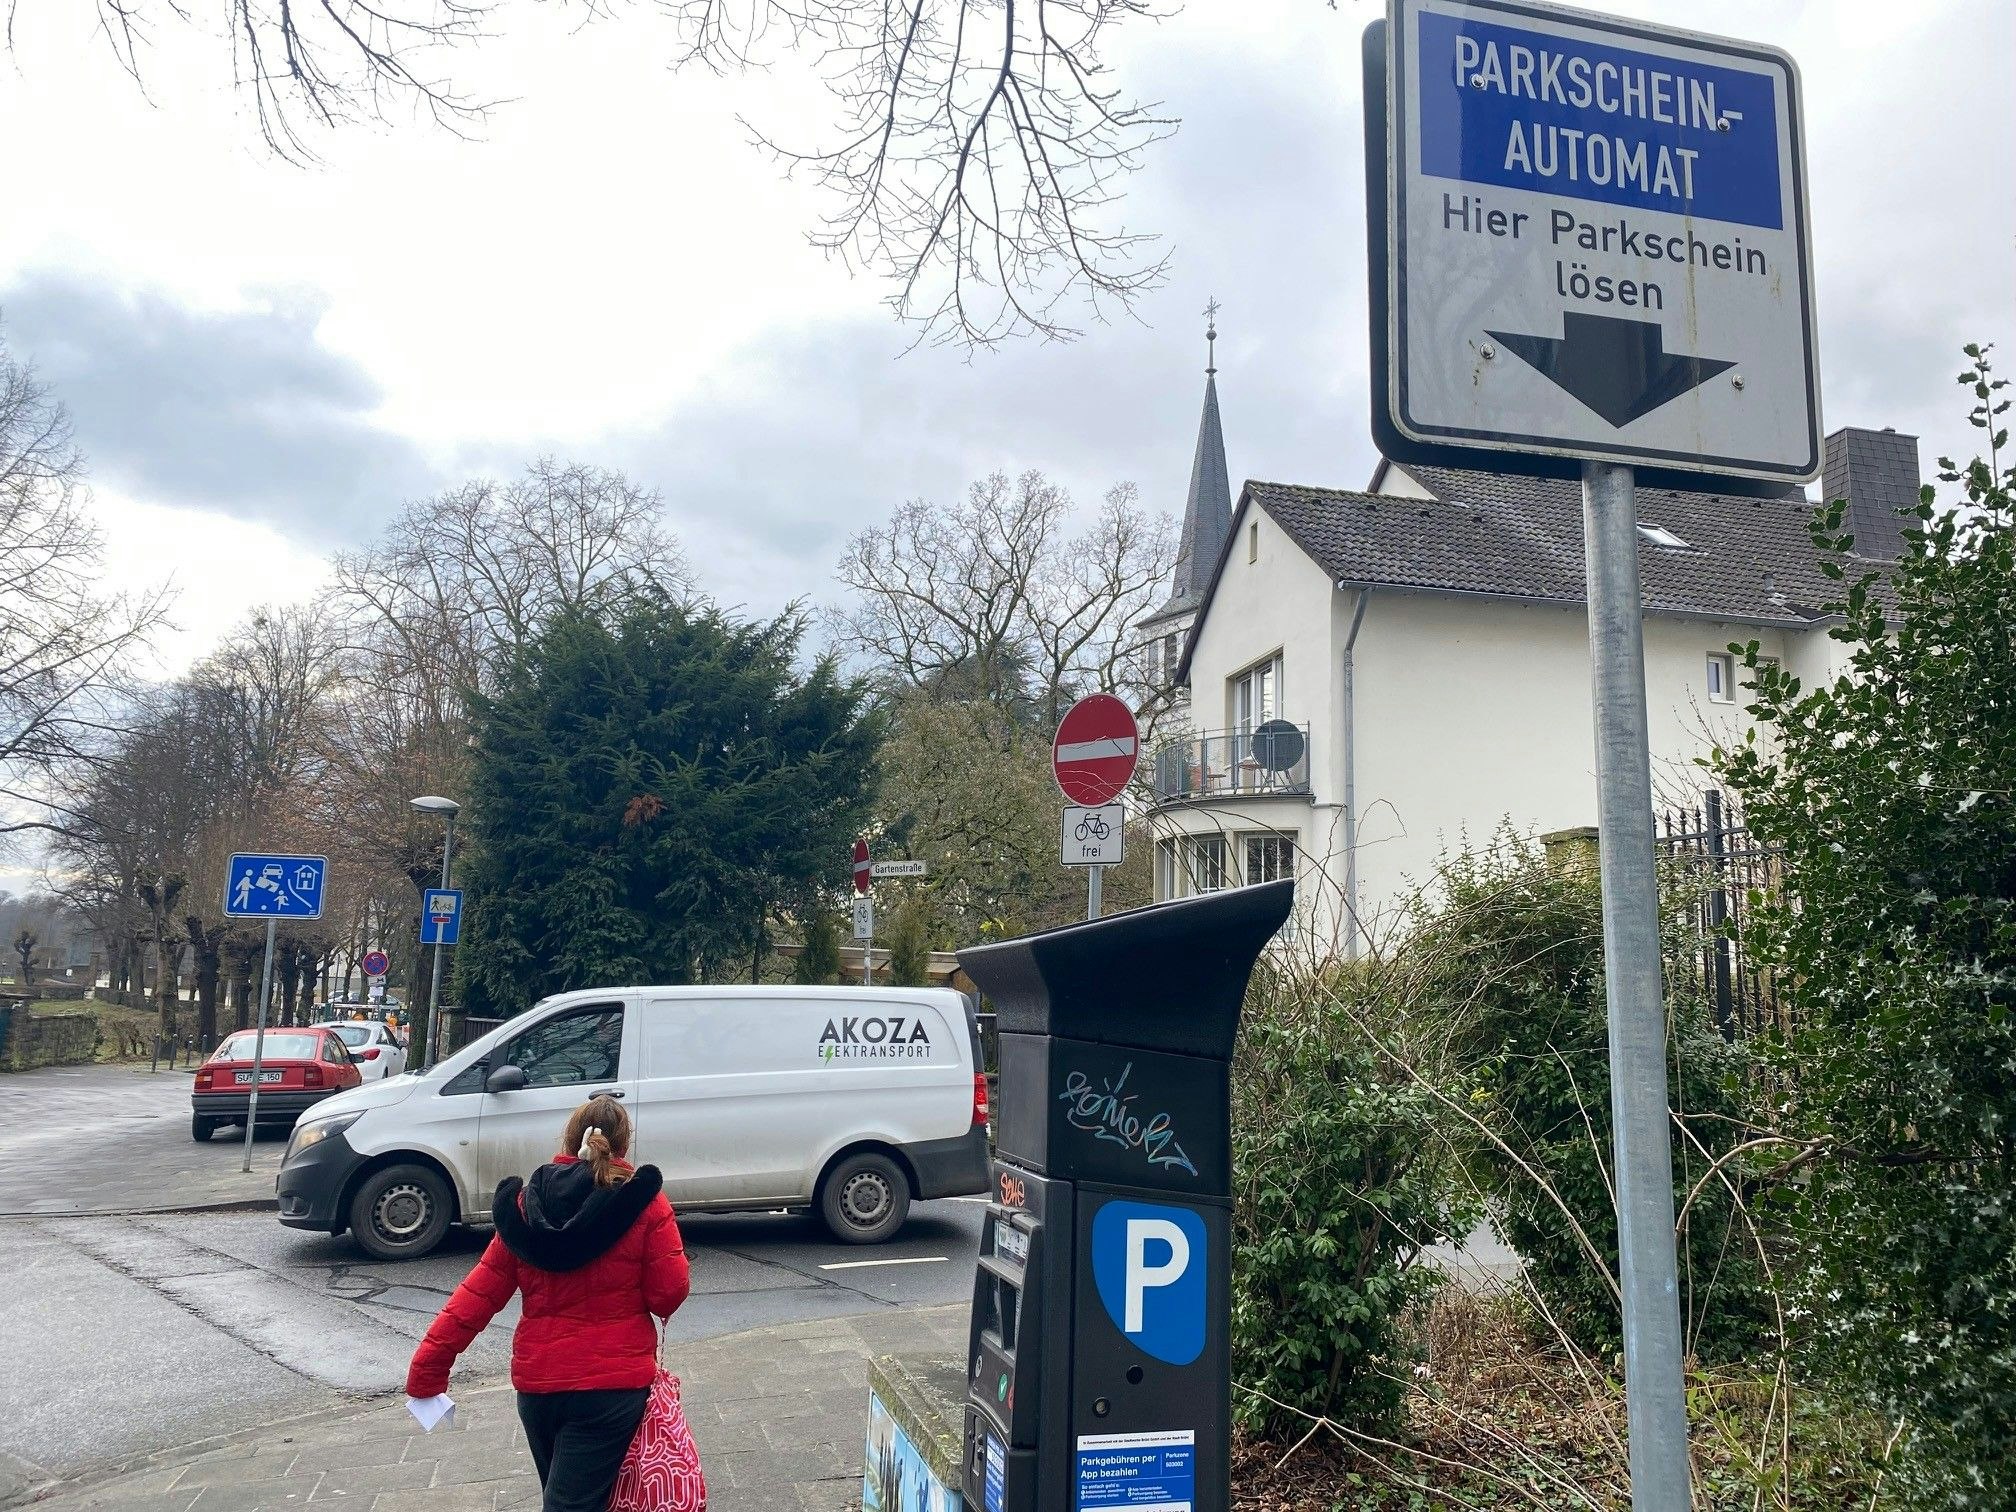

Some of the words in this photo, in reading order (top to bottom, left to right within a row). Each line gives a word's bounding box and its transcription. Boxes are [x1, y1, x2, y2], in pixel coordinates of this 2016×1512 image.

[1455, 35, 1744, 132] PARKSCHEIN-
[1503, 119, 1699, 200] AUTOMAT
[1443, 193, 1529, 239] Hier
[1551, 209, 1767, 275] Parkschein
[1556, 261, 1663, 309] lösen
[1081, 844, 1102, 858] frei
[875, 863, 922, 874] Gartenstraße
[818, 1016, 930, 1044] AKOZA
[818, 1045, 931, 1059] EEKTRANSPORT
[1125, 1219, 1190, 1332] P
[1081, 1455, 1140, 1466] Parkgebühren
[1142, 1455, 1156, 1464] per
[1081, 1470, 1098, 1479] App
[1100, 1467, 1138, 1477] bezahlen
